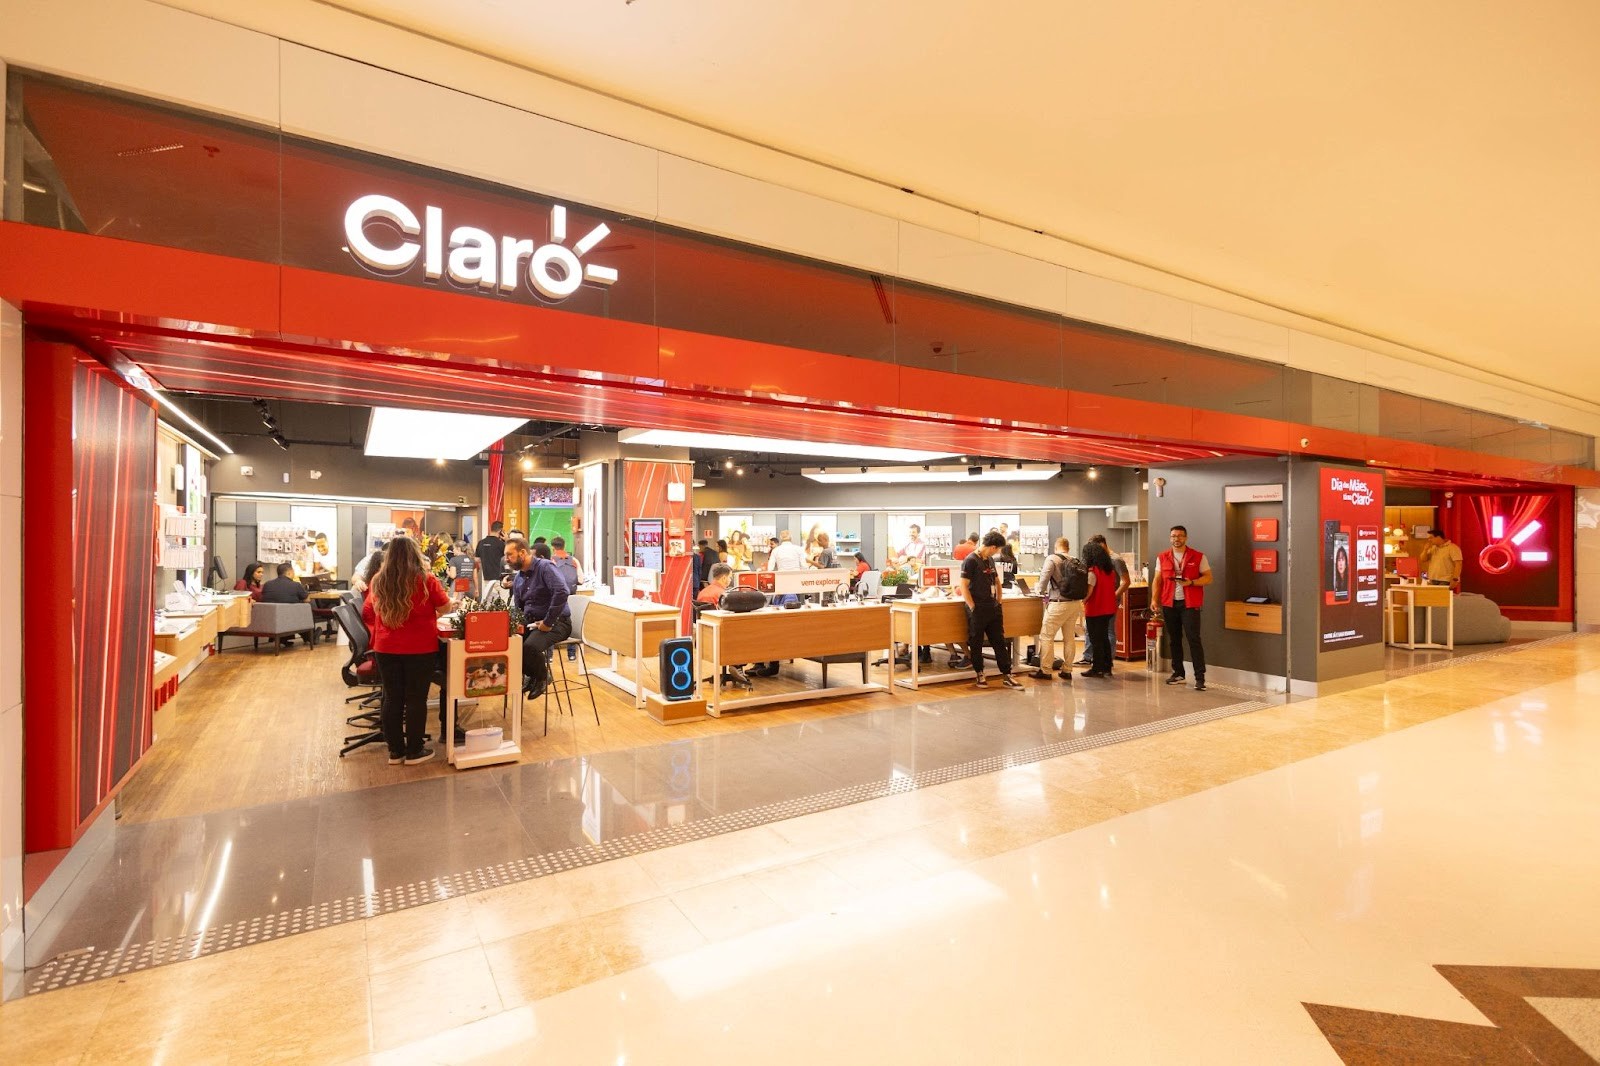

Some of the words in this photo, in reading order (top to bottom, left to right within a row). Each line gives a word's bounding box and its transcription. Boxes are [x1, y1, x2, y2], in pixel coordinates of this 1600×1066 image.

[343, 193, 618, 300] Claro
[1331, 477, 1343, 491] Dia
[1351, 490, 1373, 506] Claro
[1365, 545, 1377, 561] 48
[815, 578, 841, 587] explorar
